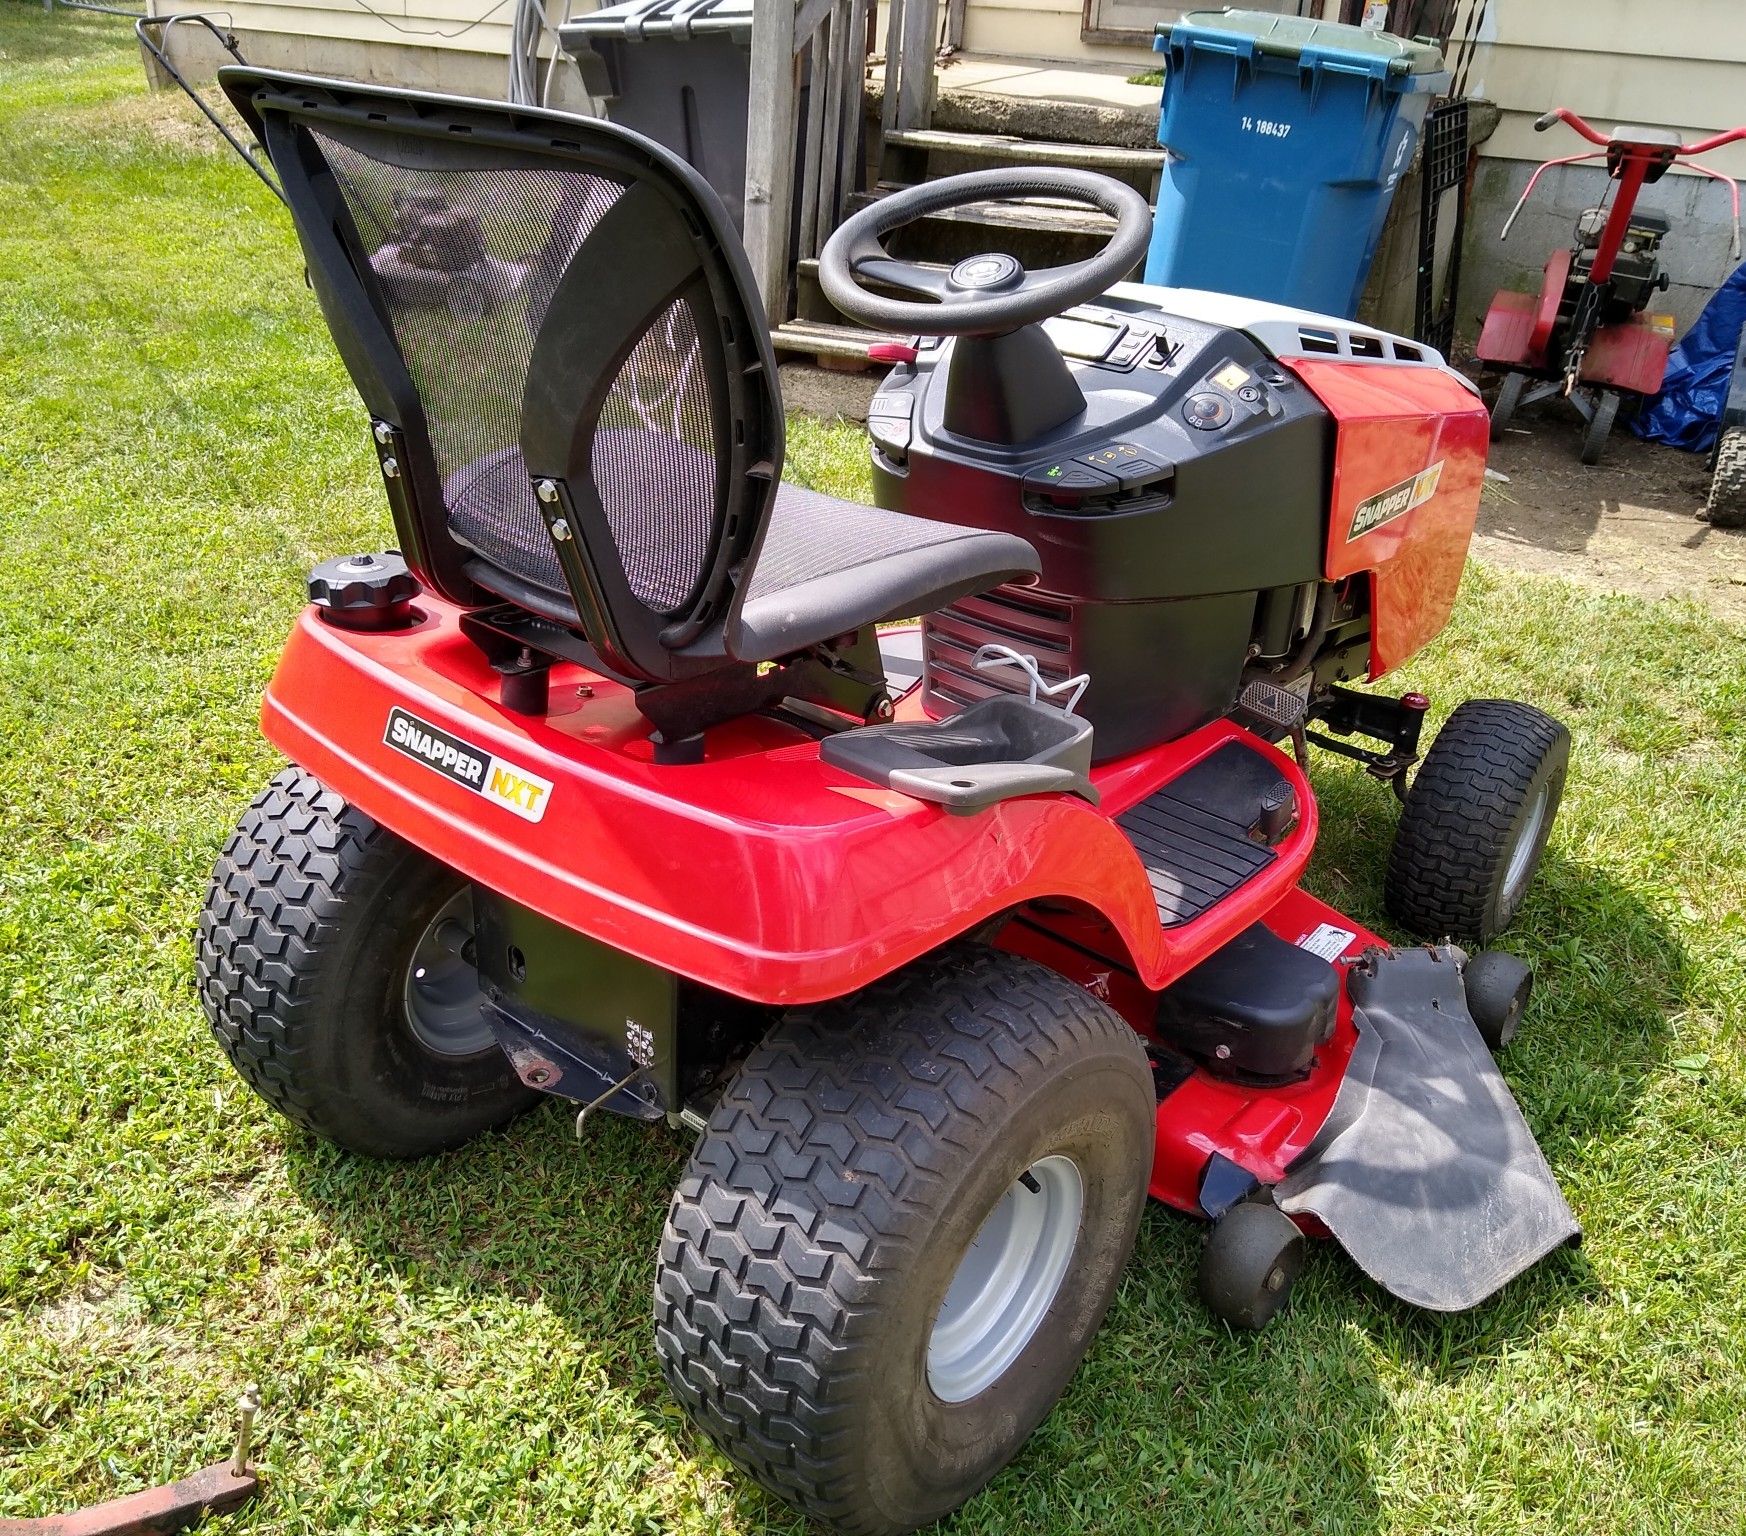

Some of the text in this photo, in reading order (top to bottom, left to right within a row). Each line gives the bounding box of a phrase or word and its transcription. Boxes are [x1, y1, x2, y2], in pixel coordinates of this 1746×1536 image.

[1241, 116, 1291, 138] 14 188437
[1353, 487, 1411, 532] SNAPPER
[391, 717, 544, 810] SNAPPER NXT
